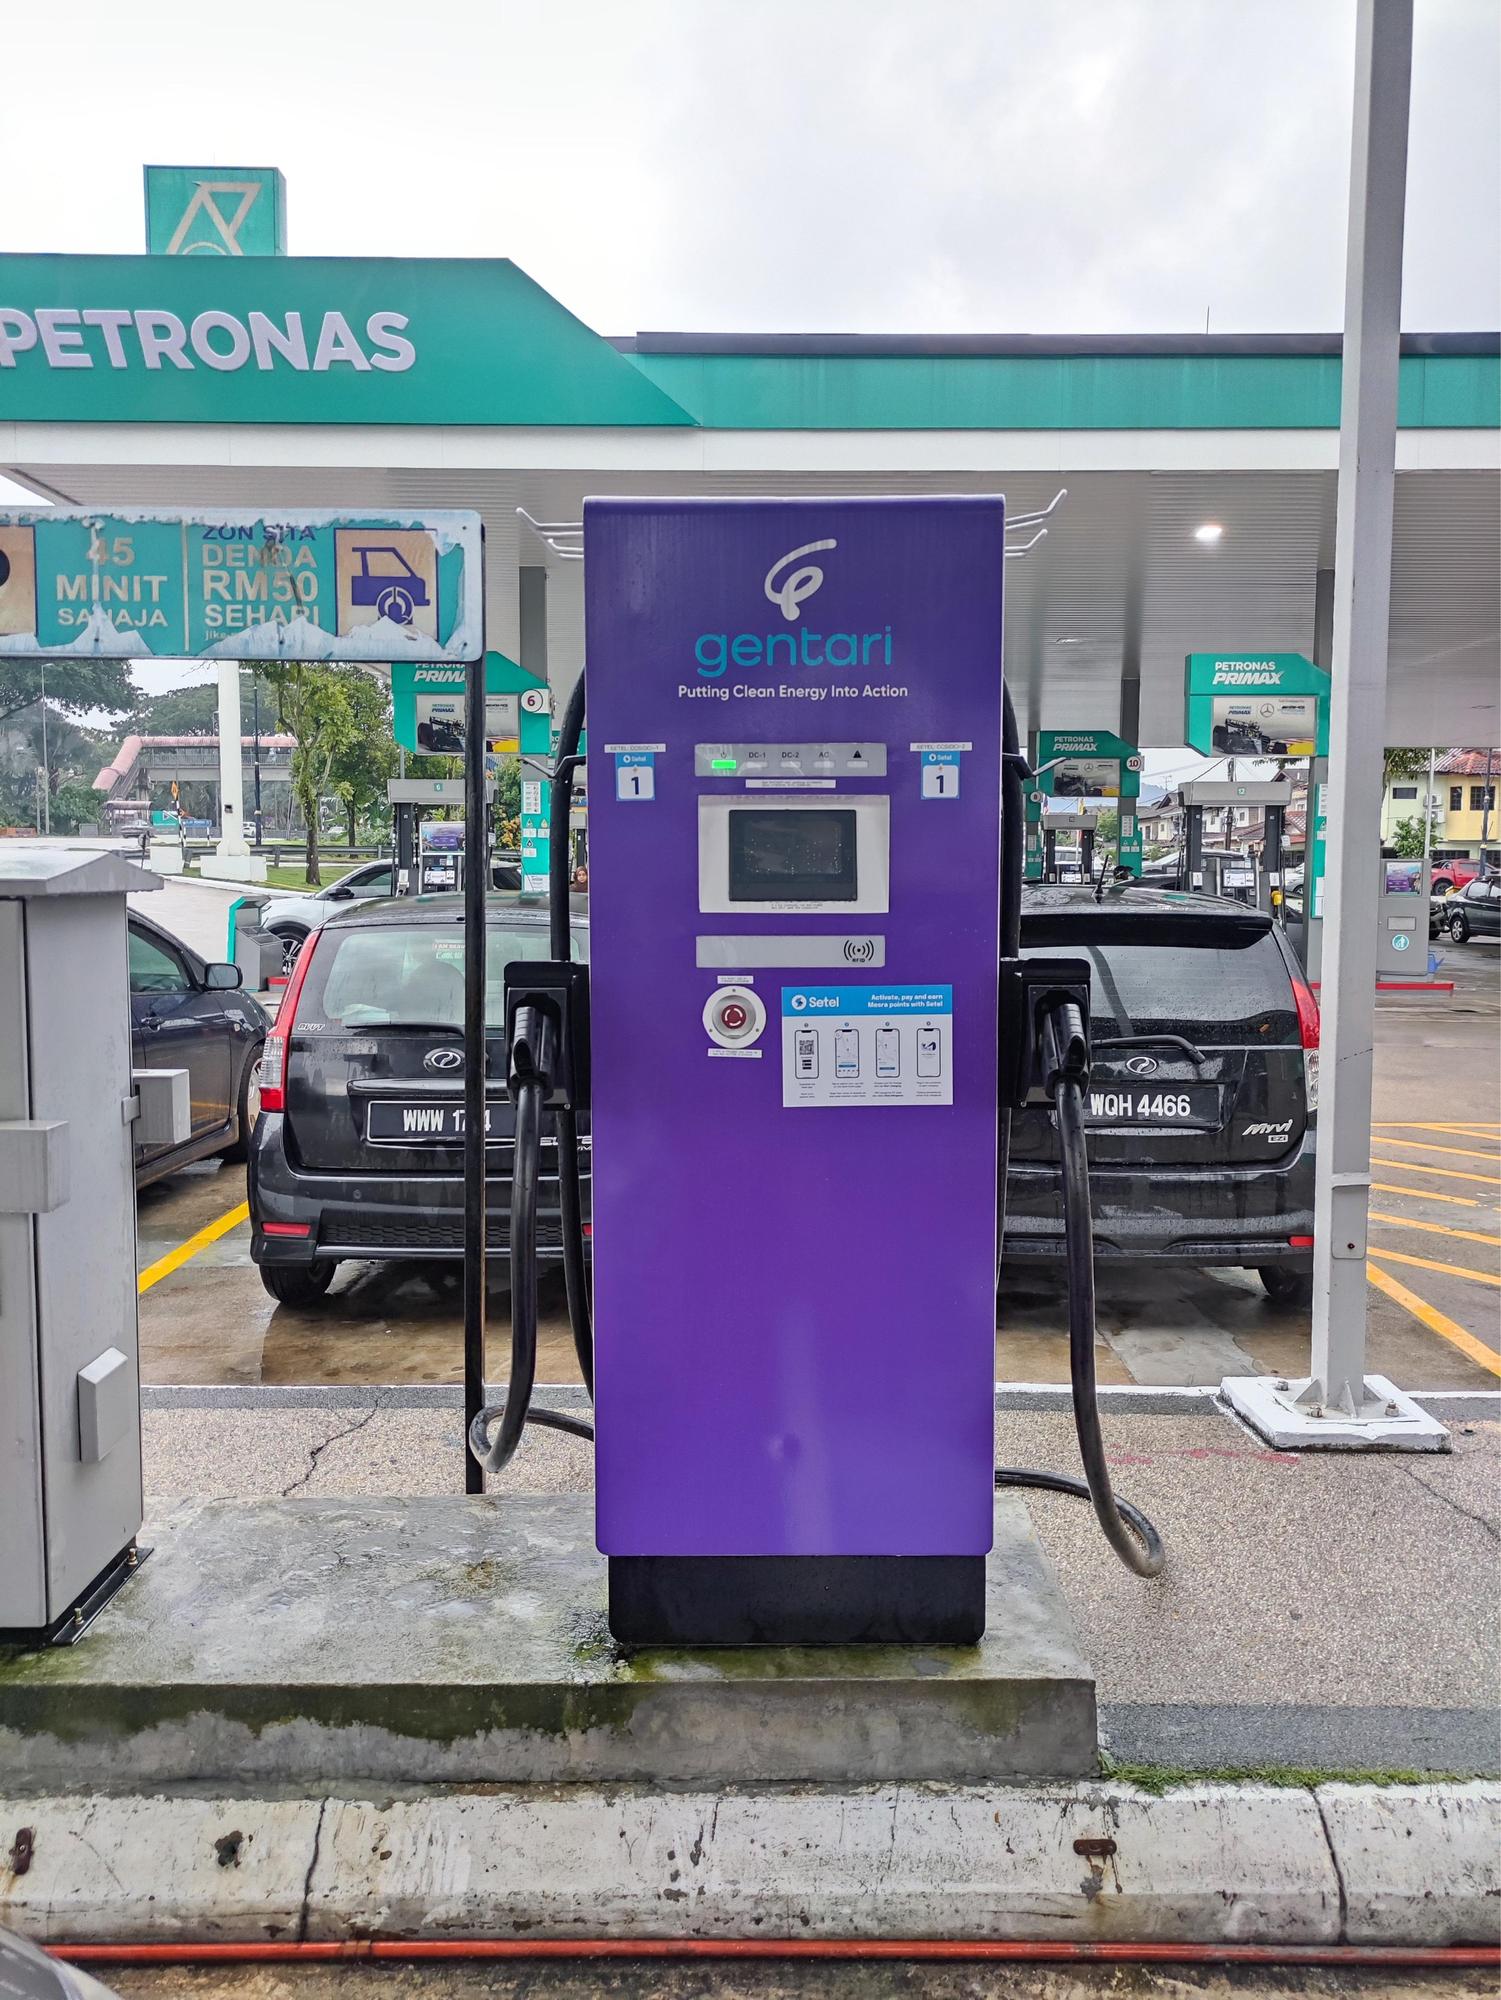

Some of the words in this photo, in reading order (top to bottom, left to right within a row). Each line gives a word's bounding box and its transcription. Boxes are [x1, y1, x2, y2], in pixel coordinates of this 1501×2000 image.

[0, 308, 417, 374] PETRONAS
[202, 525, 254, 541] ZON
[56, 574, 168, 602] MINIT
[203, 569, 319, 602] RM50
[57, 607, 169, 627] SAAJA
[695, 625, 892, 678] gentari
[1215, 661, 1276, 671] PETRONAS
[413, 670, 466, 683] PRIMA
[1212, 671, 1285, 685] PRIMAX
[527, 695, 536, 707] 6
[678, 685, 730, 701] Putting
[733, 685, 776, 698] Clean
[779, 685, 828, 700] Energy
[831, 685, 859, 698] Into
[862, 684, 908, 697] Action
[1129, 758, 1141, 768] 10
[631, 776, 640, 795] 1
[936, 775, 944, 794] 1
[809, 997, 839, 1008] Setel
[889, 1001, 910, 1009] points
[1090, 1093, 1133, 1116] WQH
[1136, 1094, 1191, 1116] 4466
[403, 1109, 444, 1131] WWW
[1242, 1118, 1293, 1136] Myvi
